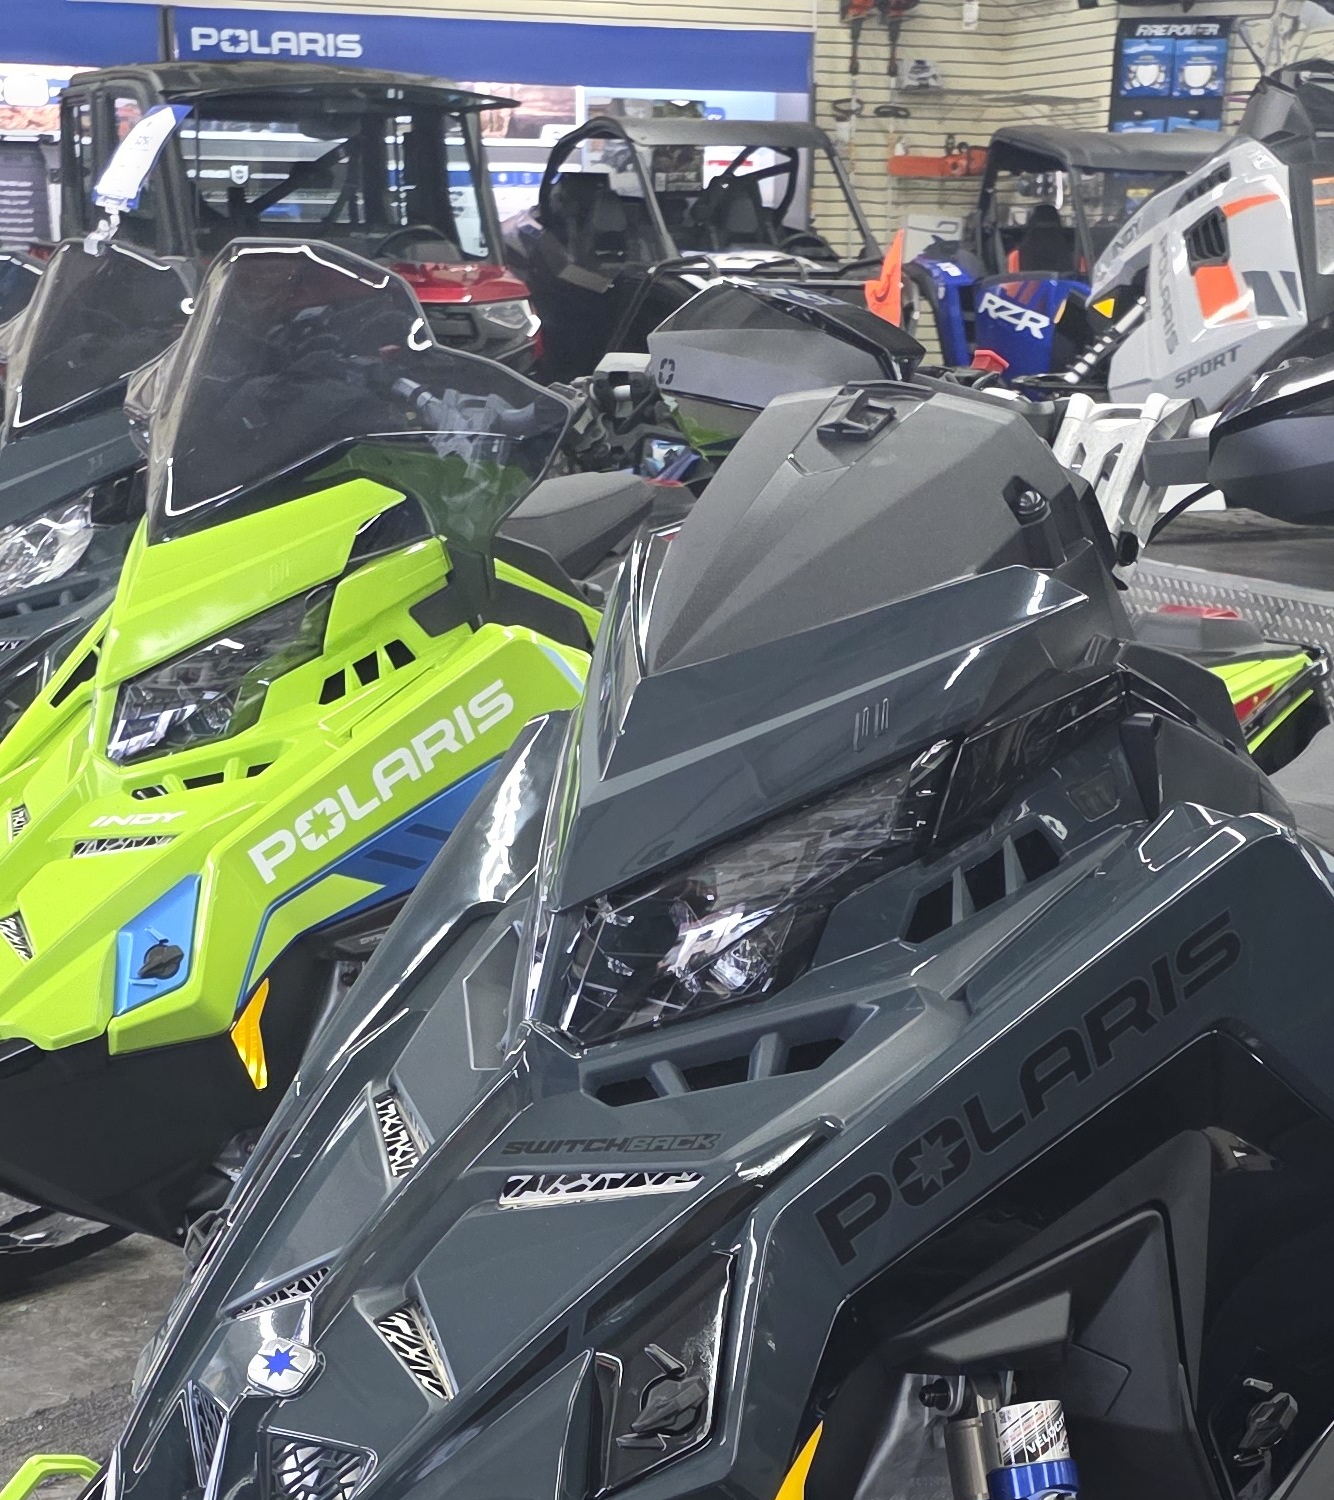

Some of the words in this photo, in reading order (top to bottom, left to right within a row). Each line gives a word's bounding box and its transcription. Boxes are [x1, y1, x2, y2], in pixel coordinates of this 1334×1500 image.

[190, 26, 363, 59] POLARIS
[978, 292, 1050, 340] RZR
[1174, 345, 1243, 389] SPORT
[248, 679, 515, 886] POLARIS
[89, 811, 185, 828] INDY
[814, 908, 1244, 1267] POLARIS
[499, 1133, 723, 1156] SWITCHBACK
